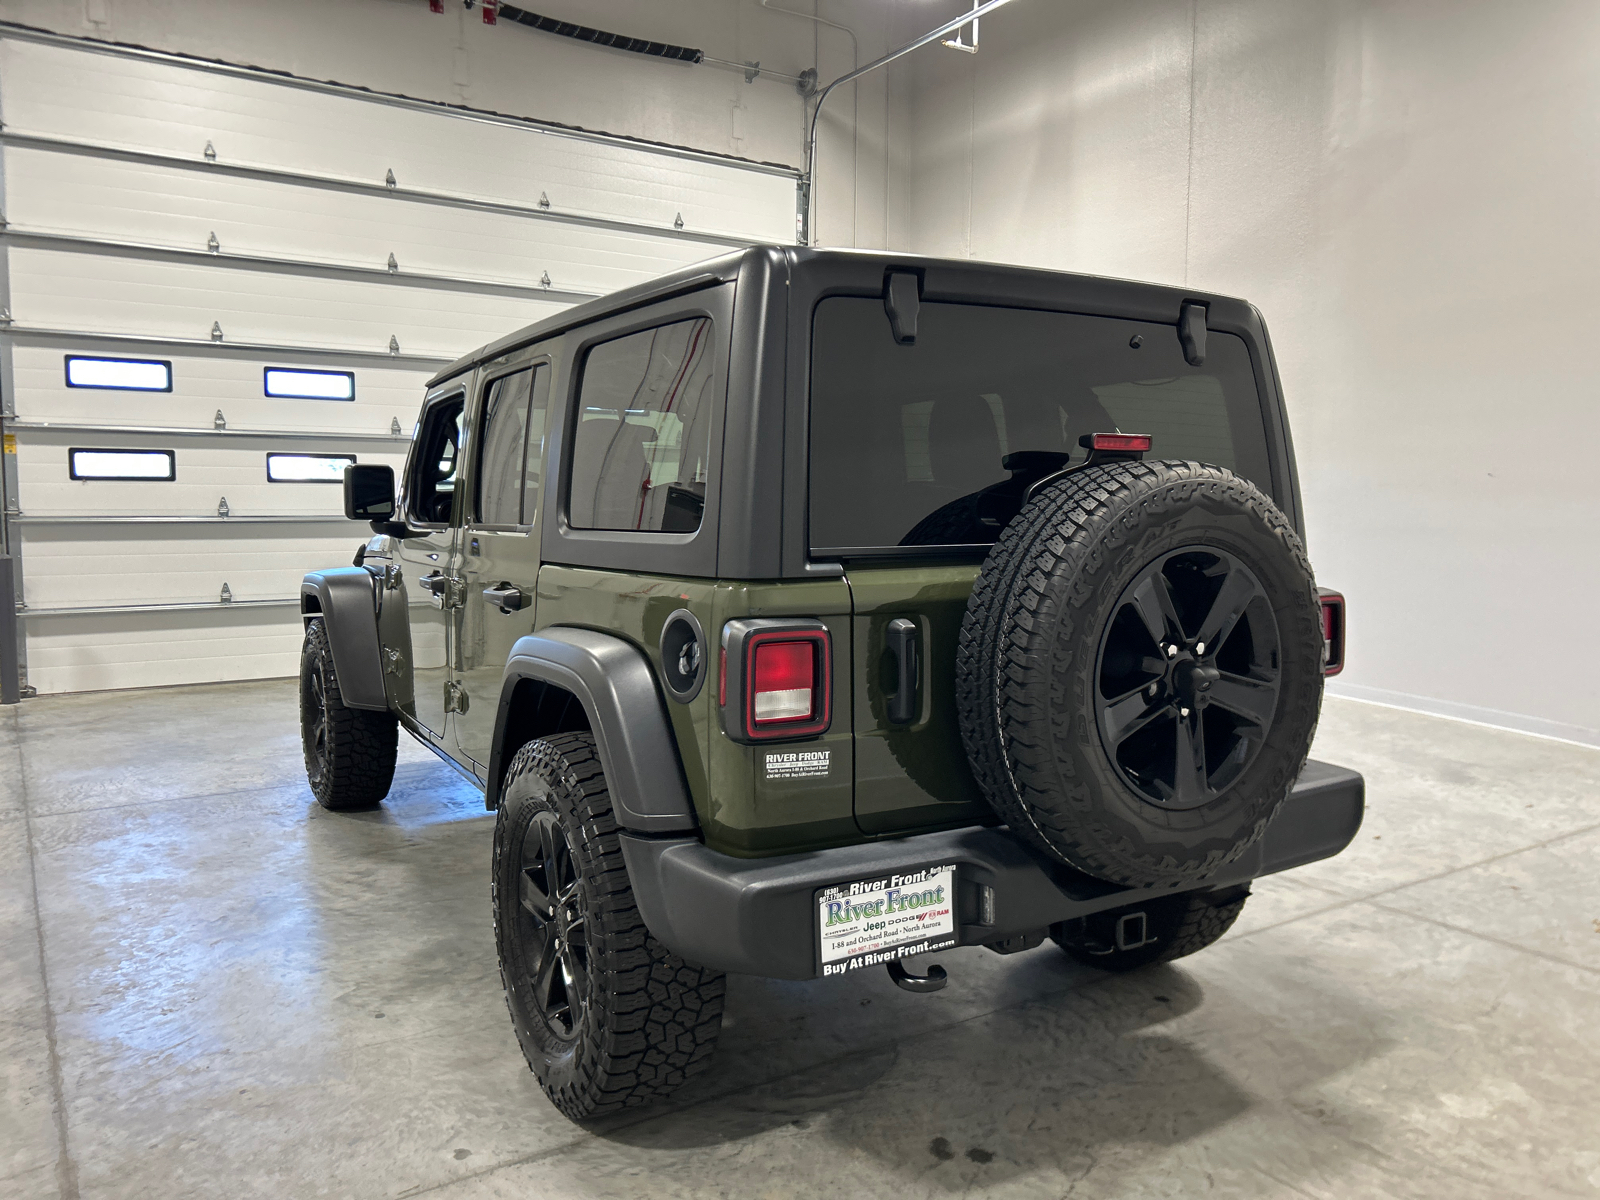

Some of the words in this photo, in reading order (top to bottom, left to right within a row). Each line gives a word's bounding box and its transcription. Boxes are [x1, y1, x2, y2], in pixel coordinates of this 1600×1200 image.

[766, 753, 796, 763] RIVER
[798, 751, 830, 761] FRONT
[850, 879, 887, 896] River
[891, 870, 926, 888] Front
[825, 898, 885, 927] River
[885, 884, 945, 914] Front
[863, 921, 886, 932] Jeep
[888, 914, 920, 925] DODGE
[936, 909, 949, 917] RAM
[832, 940, 845, 950] I-88
[846, 937, 857, 946] and
[858, 933, 882, 943] Orchard
[884, 929, 899, 938] Road
[903, 923, 920, 934] North
[921, 921, 941, 930] Aurora
[823, 962, 847, 976] Buy
[849, 956, 863, 970] At
[864, 949, 896, 966] River
[897, 939, 955, 958] Front.com
